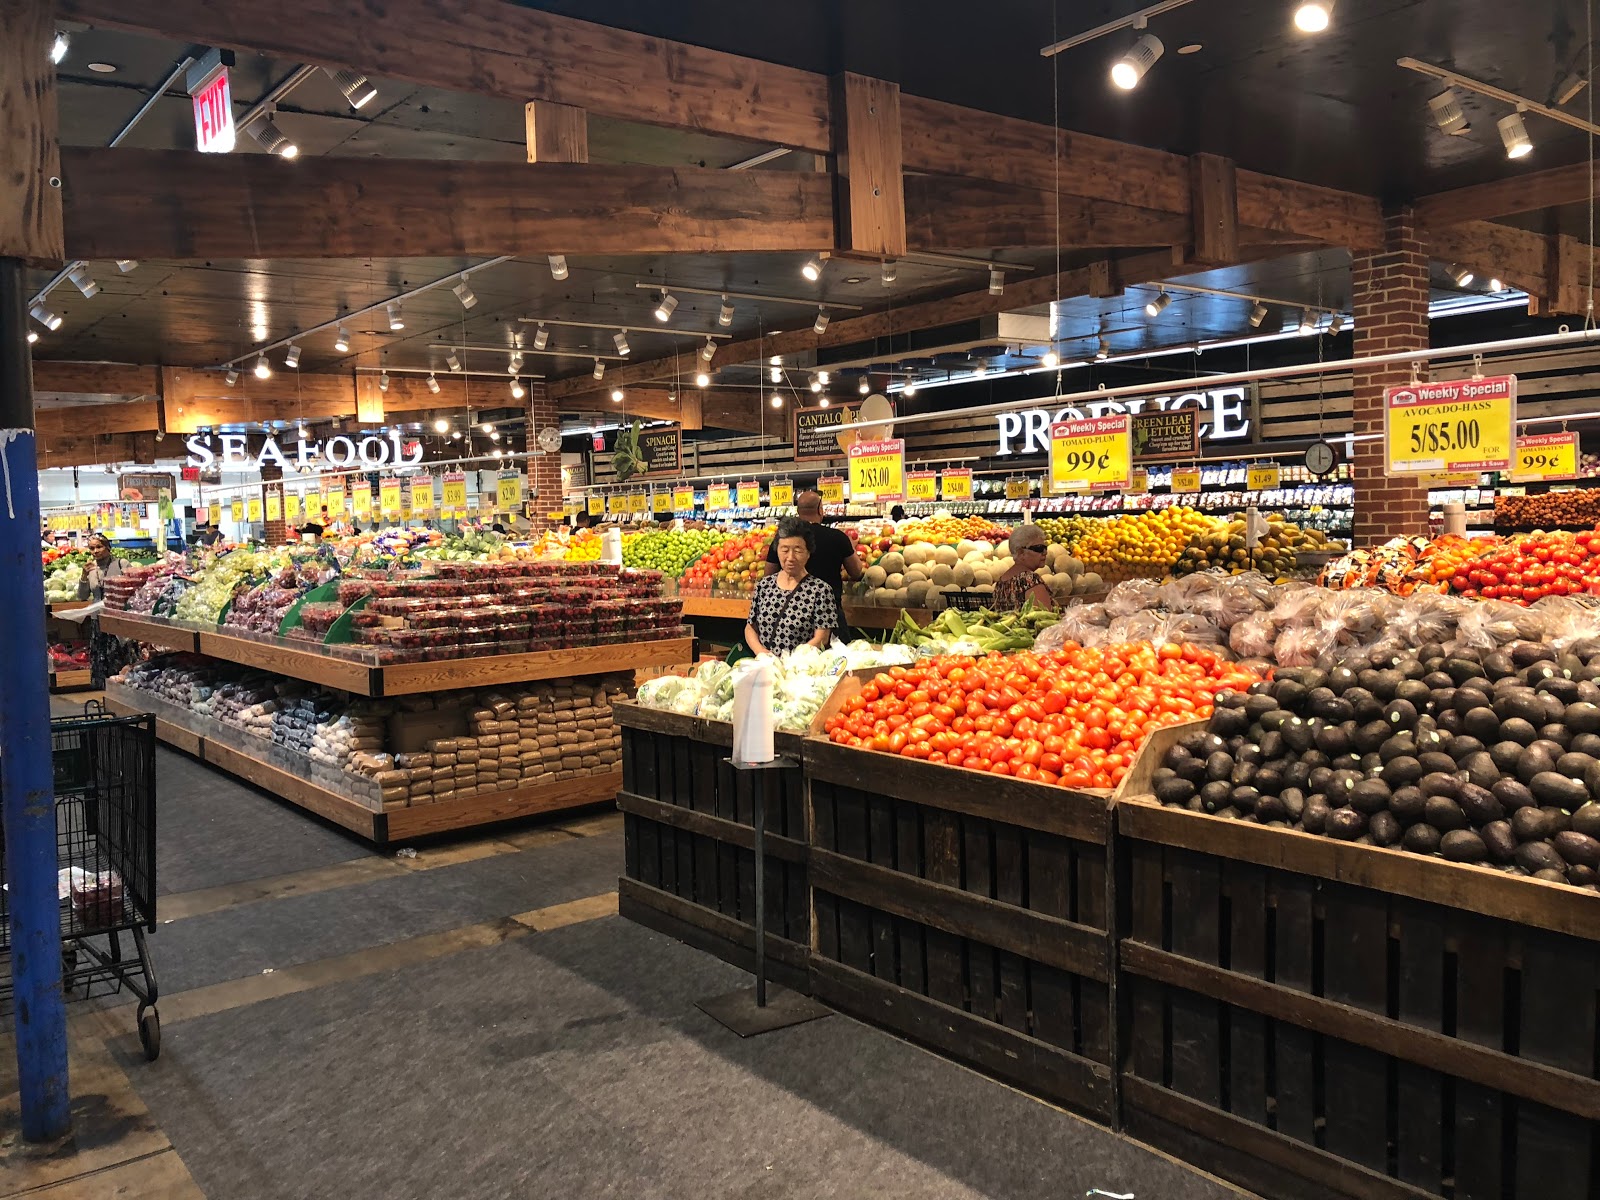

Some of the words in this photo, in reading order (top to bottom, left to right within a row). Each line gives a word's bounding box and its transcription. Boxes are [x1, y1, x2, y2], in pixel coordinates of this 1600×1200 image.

[199, 76, 226, 146] EXIT
[1418, 387, 1459, 400] Weekly
[1463, 382, 1506, 397] Special
[1403, 401, 1492, 417] AVOCADO-HASS
[799, 410, 860, 427] CANTALOP
[996, 387, 1249, 456] PRCE
[1165, 414, 1191, 425] LEAF
[1070, 422, 1095, 433] Weekly
[1098, 419, 1125, 432] Special
[1145, 424, 1191, 437] LETTUCE
[646, 435, 676, 447] SPINACH
[1061, 435, 1115, 447] TOMATO-PLUM
[1411, 419, 1480, 454] 5/$5.00
[1526, 437, 1548, 445] Weekly
[1549, 435, 1572, 443] Special
[187, 434, 423, 466] SEAFOOD
[862, 445, 880, 454] Weekly
[881, 443, 900, 452] Special
[1483, 446, 1500, 454] FOR
[857, 455, 893, 464] CAULIFLOWER
[1067, 449, 1110, 475] 99¢
[1523, 454, 1559, 470] 99¢
[860, 467, 889, 487] 2/$3.00
[1254, 475, 1271, 484] $1.49
[911, 484, 928, 495] 5/$5.00
[947, 482, 963, 493] 2/$4.00
[416, 493, 428, 505] $1.99
